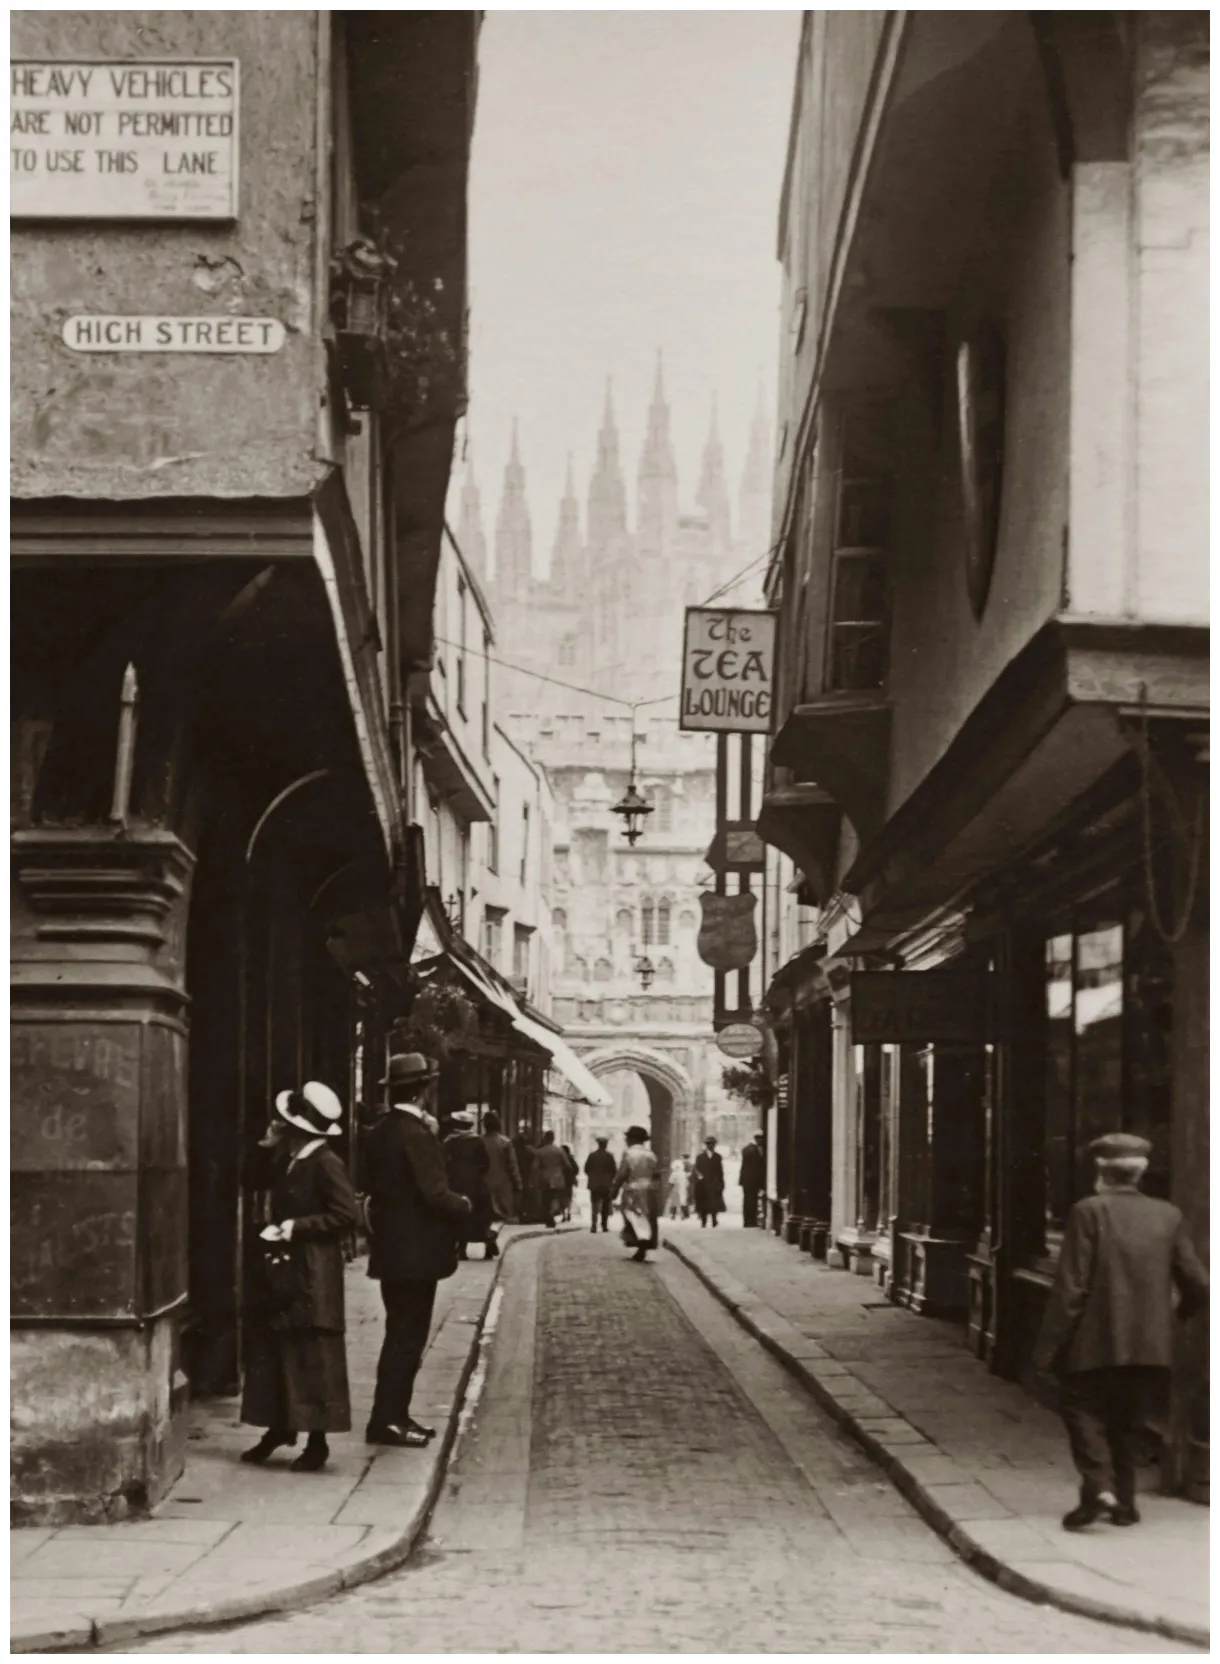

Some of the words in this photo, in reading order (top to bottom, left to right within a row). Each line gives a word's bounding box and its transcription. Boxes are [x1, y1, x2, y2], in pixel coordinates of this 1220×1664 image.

[11, 69, 93, 97] HEAVY
[109, 70, 233, 98] VEHICLES
[11, 110, 50, 135] ARE
[64, 111, 104, 136] NOT
[118, 112, 233, 137] PERMITTED
[11, 149, 37, 172] TO
[46, 149, 85, 173] USE
[94, 150, 138, 174] THIS
[163, 151, 219, 175] LANE
[76, 319, 142, 344] HIGH
[156, 321, 274, 346] STREET
[706, 617, 752, 644] The
[691, 648, 768, 682] TEA
[684, 687, 771, 719] LOUNGE
